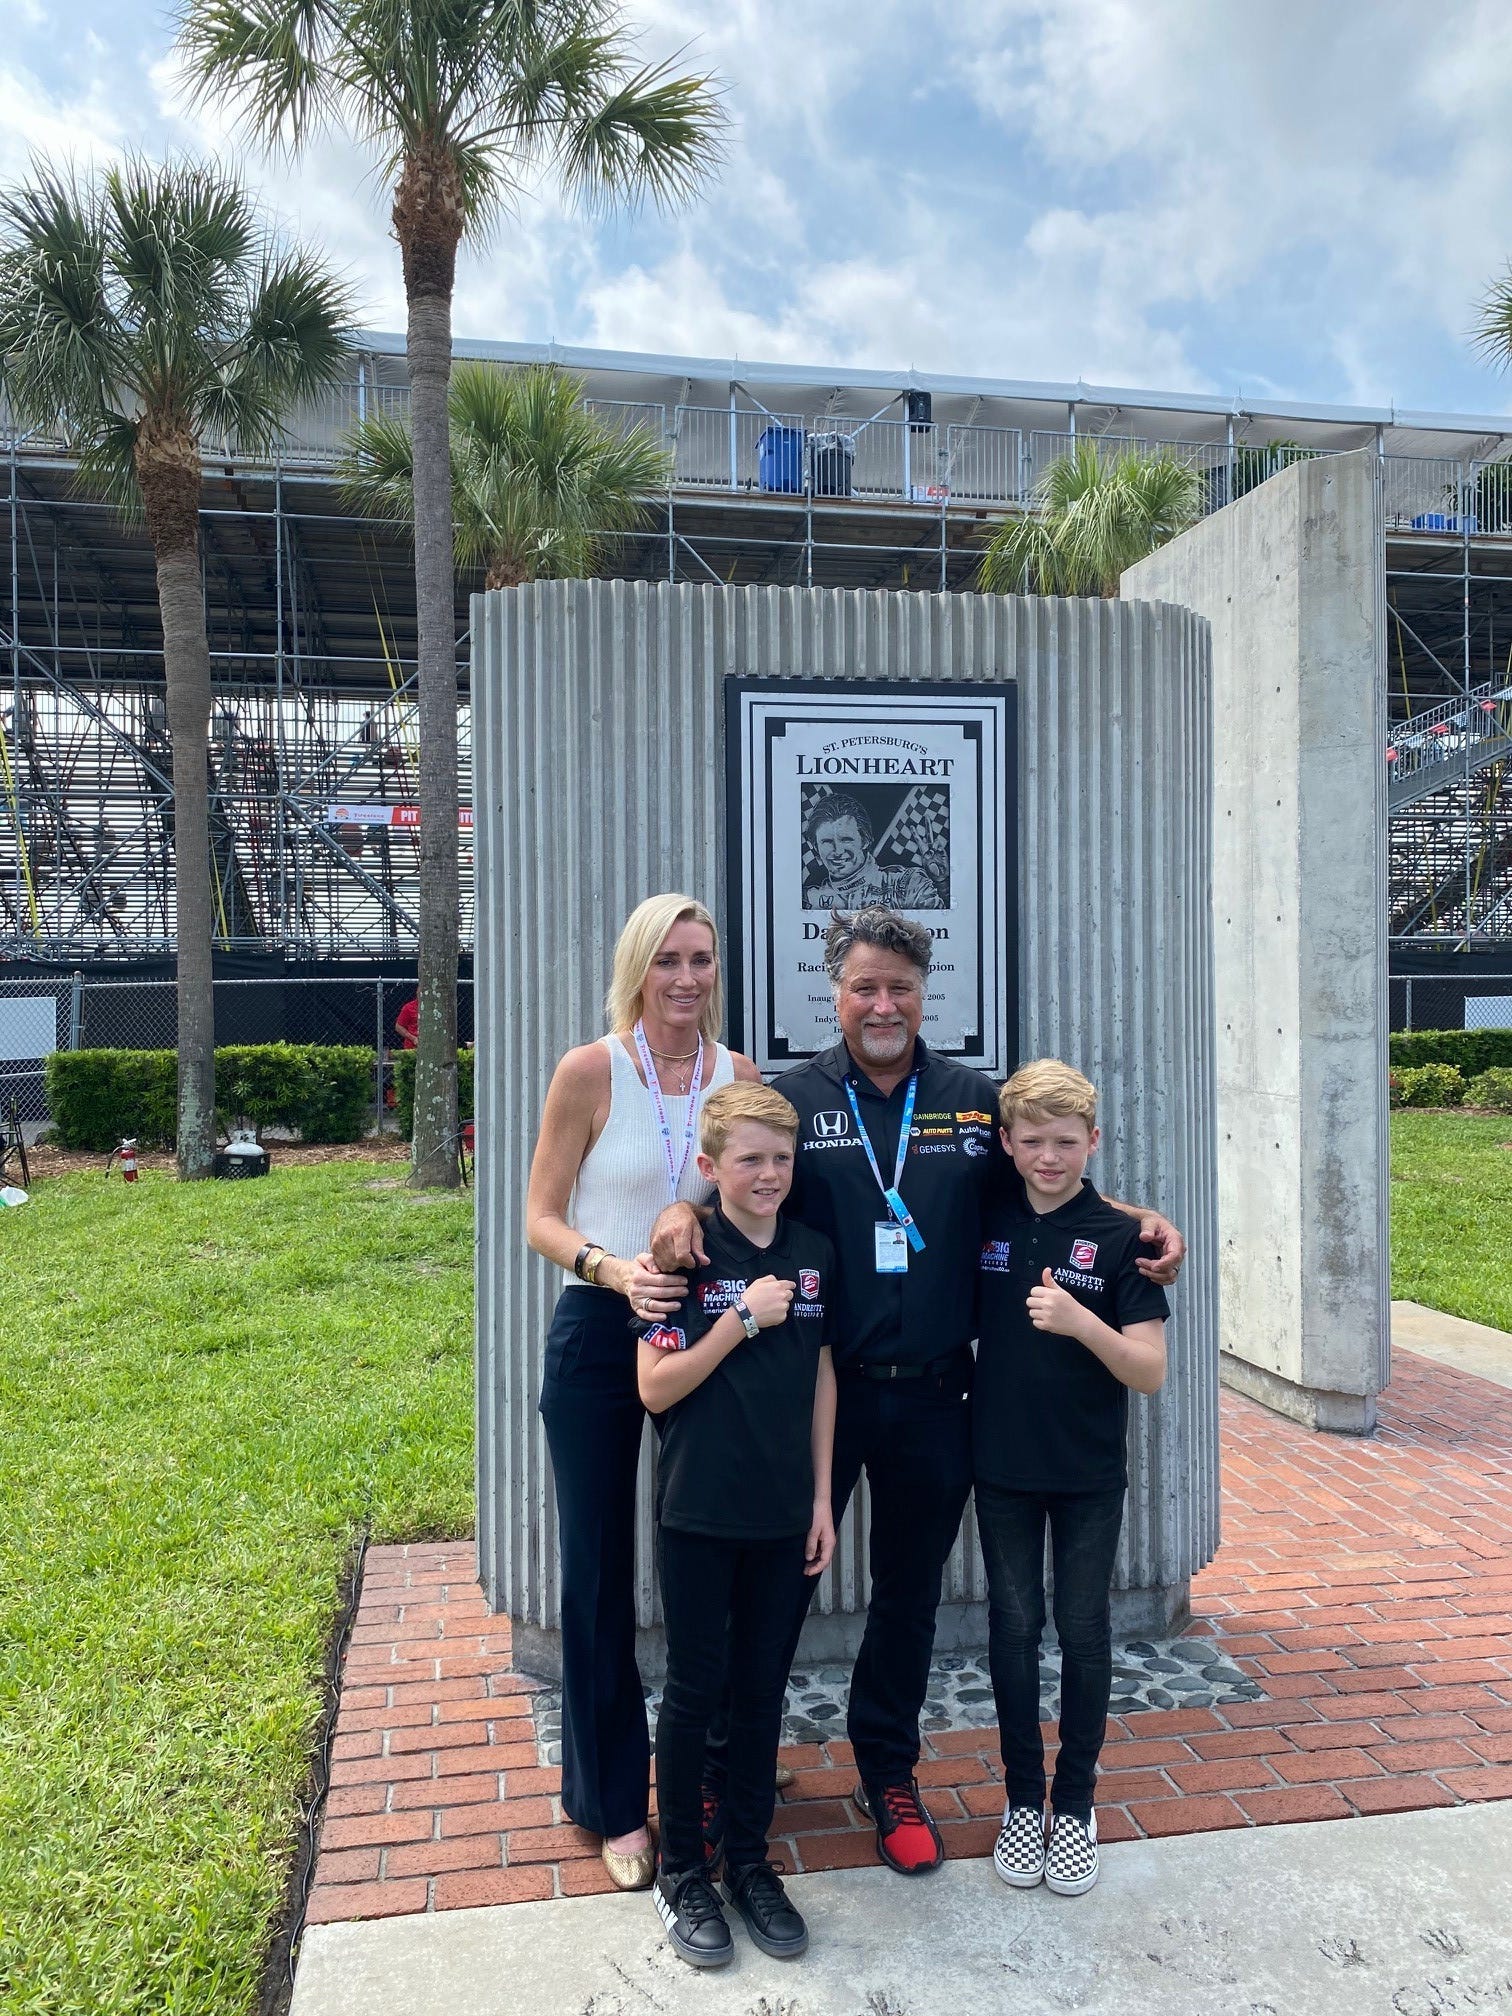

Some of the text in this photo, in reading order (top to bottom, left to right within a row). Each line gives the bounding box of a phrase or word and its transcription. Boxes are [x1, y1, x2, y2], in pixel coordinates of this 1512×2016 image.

[822, 735, 928, 755] ST. PETERSBURG'S
[795, 754, 954, 776] LIONHEART
[401, 810, 418, 822] PIT
[802, 922, 828, 940] Da
[797, 962, 955, 974] Raci pion
[808, 993, 946, 1004] Inaug 2005
[814, 1014, 939, 1024] IndyC 2005
[913, 1112, 952, 1121] GAINBRIDGE
[803, 1138, 864, 1151] HONDA
[919, 1143, 957, 1154] GENESYS
[994, 1241, 1010, 1254] BIG
[980, 1252, 1010, 1262] MACHINE
[1055, 1267, 1104, 1287] ANDRETTI
[722, 1280, 746, 1293] BIG
[1053, 1275, 1104, 1292] AUTOSPORT
[704, 1292, 741, 1303] MACHIN
[794, 1302, 824, 1312] ANDRETTI
